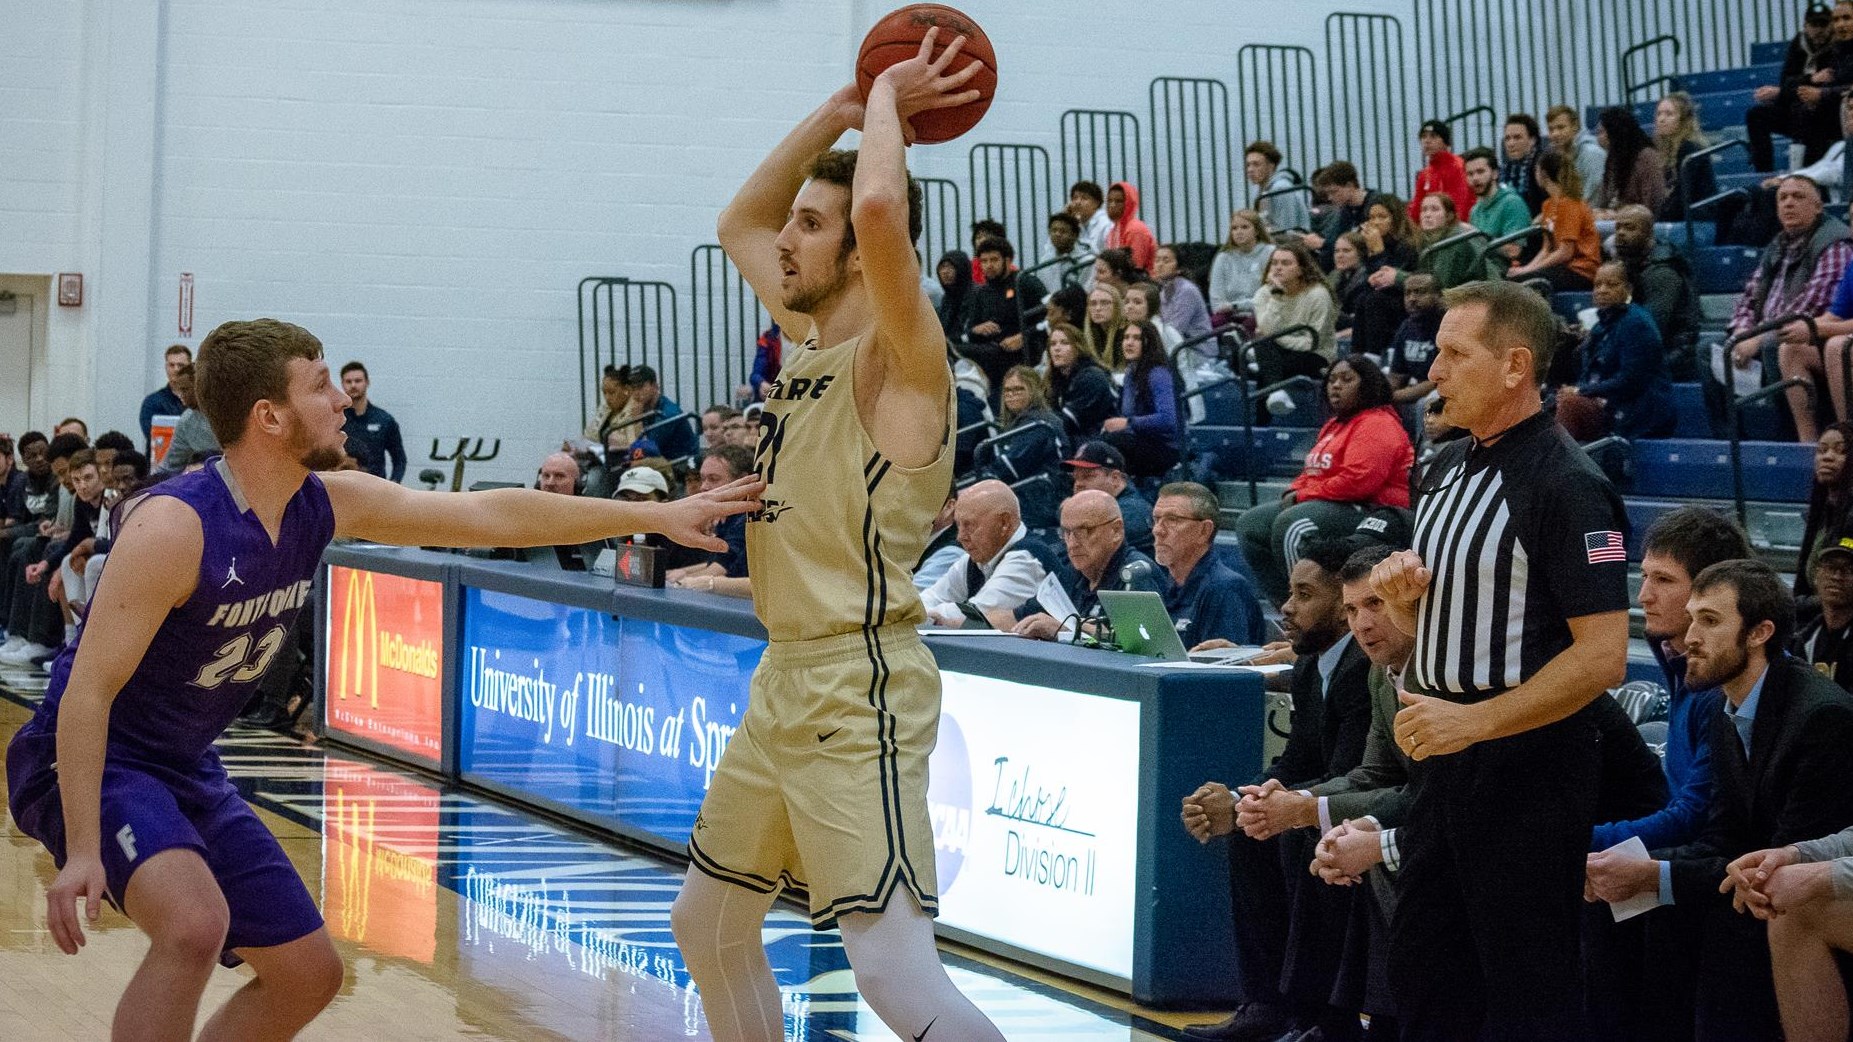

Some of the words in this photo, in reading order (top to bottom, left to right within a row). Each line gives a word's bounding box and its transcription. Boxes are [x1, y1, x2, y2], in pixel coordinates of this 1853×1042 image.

[186, 623, 288, 690] 23
[380, 630, 438, 679] McDonalds
[470, 646, 557, 744] University
[560, 671, 583, 746] of
[586, 672, 654, 755] Illinois
[659, 707, 685, 758] at
[116, 823, 138, 863] F
[926, 800, 971, 858] CAA
[1005, 830, 1079, 893] Division
[1085, 848, 1096, 897] II
